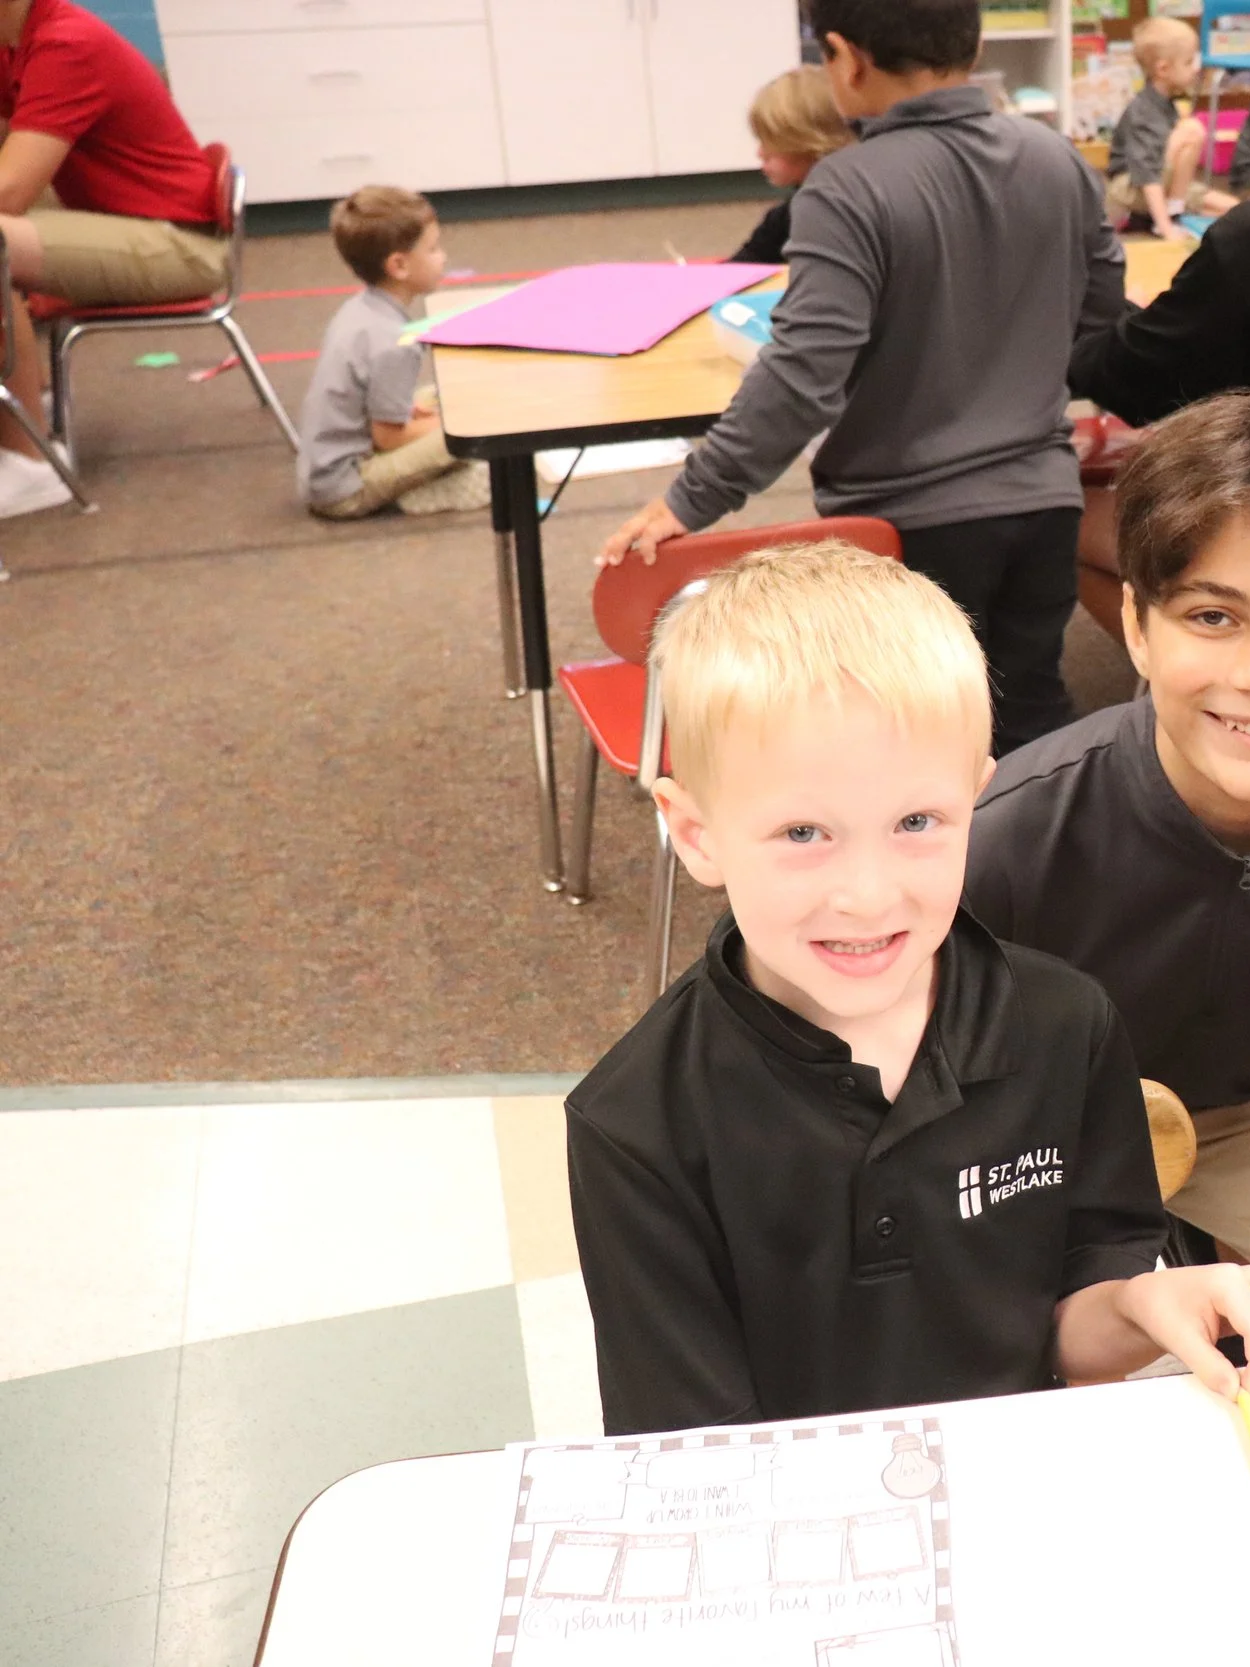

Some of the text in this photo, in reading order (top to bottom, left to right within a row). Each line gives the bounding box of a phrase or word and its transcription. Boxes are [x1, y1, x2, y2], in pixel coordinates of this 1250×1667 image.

[988, 1148, 1063, 1185] ST. PAUL
[989, 1170, 1063, 1204] WESTLAKE
[769, 1589, 811, 1615] my
[821, 1591, 846, 1616] of
[856, 1587, 902, 1609] few
[914, 1584, 932, 1606] A
[661, 1600, 758, 1629] favorite
